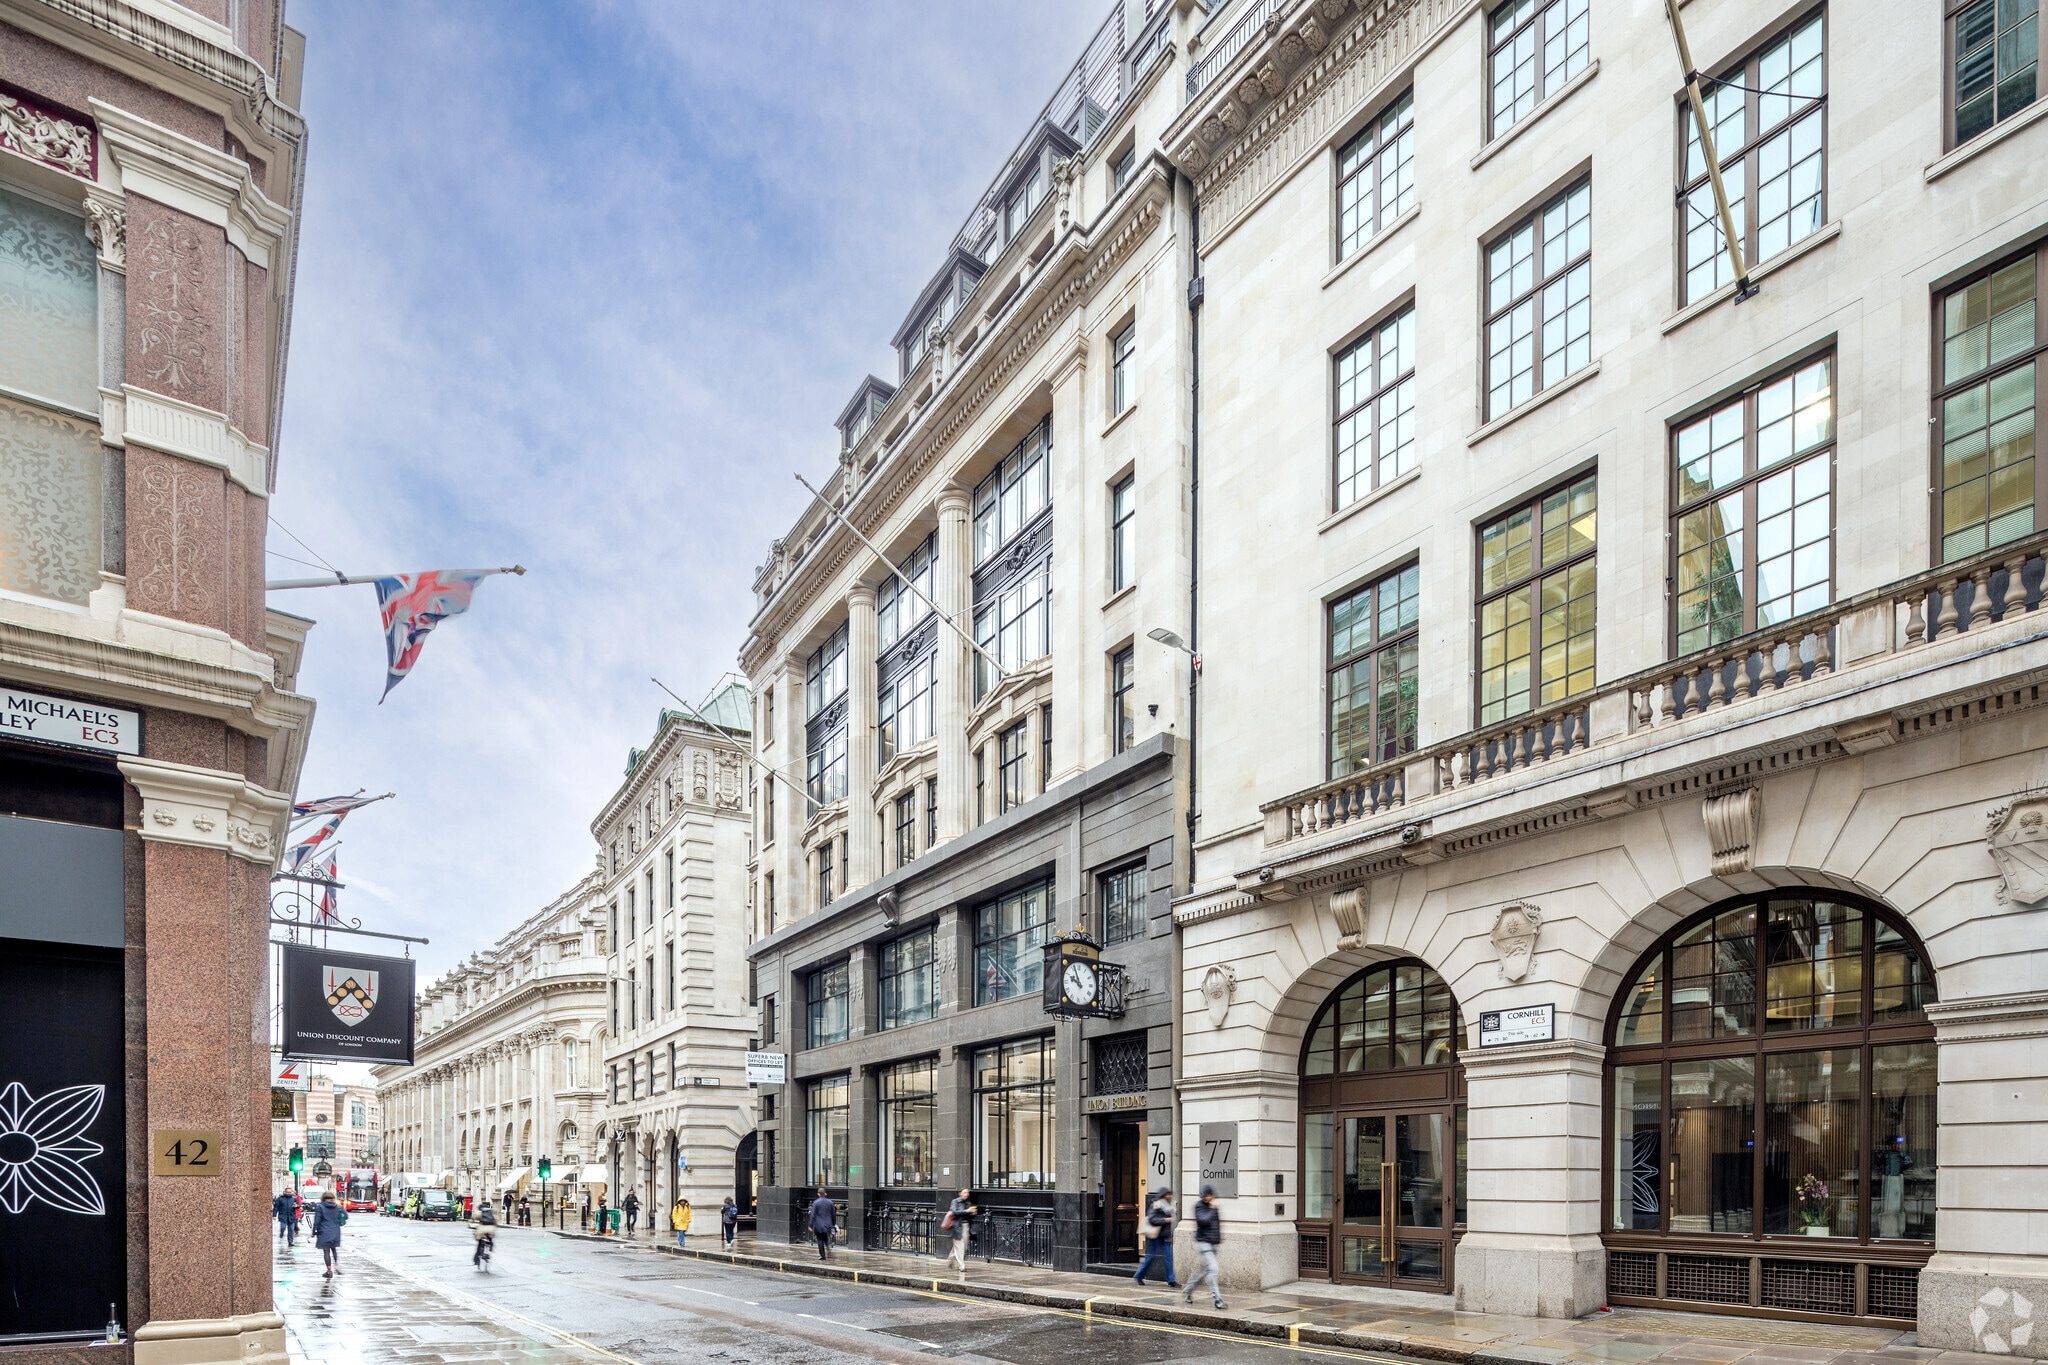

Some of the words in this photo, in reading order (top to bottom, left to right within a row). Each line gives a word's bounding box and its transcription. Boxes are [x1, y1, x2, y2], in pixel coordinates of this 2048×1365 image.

[8, 695, 119, 728] MICHAEL'S
[82, 726, 119, 745] EC3
[1507, 1009, 1545, 1019] CORNHILL
[1531, 1017, 1546, 1025] EC3
[297, 1031, 324, 1040] UNION
[326, 1033, 365, 1043] DISCOUNT
[366, 1036, 402, 1046] COMPANY
[1087, 1099, 1110, 1111] UNION
[1112, 1095, 1147, 1109] BUILDING
[164, 1139, 209, 1166] 42
[1151, 1142, 1166, 1176] 78
[1205, 1139, 1232, 1164] 77
[1202, 1168, 1235, 1180] Cornhill
